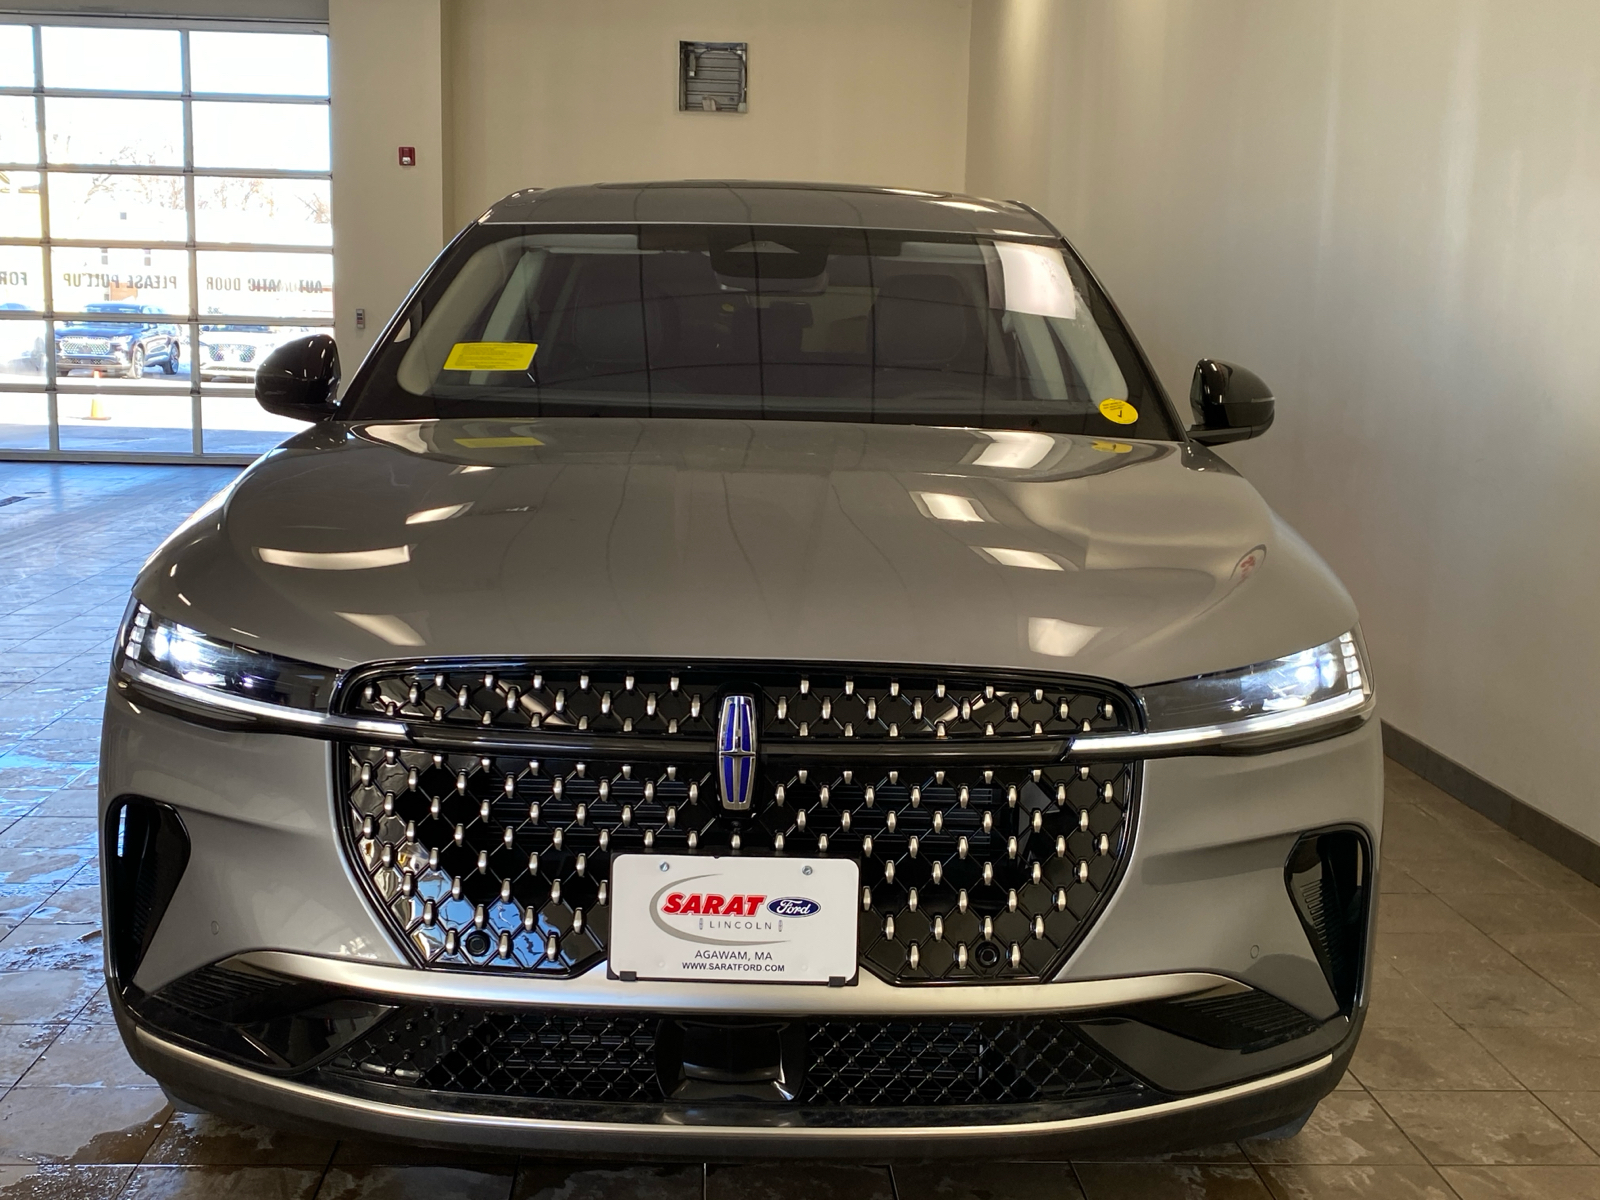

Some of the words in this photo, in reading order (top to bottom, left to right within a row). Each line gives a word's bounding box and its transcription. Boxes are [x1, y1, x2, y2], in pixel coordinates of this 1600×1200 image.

[661, 892, 767, 917] SARAT
[776, 898, 811, 916] Ford
[709, 920, 772, 931] LINCOLN
[694, 950, 751, 961] AGAWAM,
[754, 951, 773, 961] MA
[681, 961, 785, 972] WWW.SARATFORD.COM
